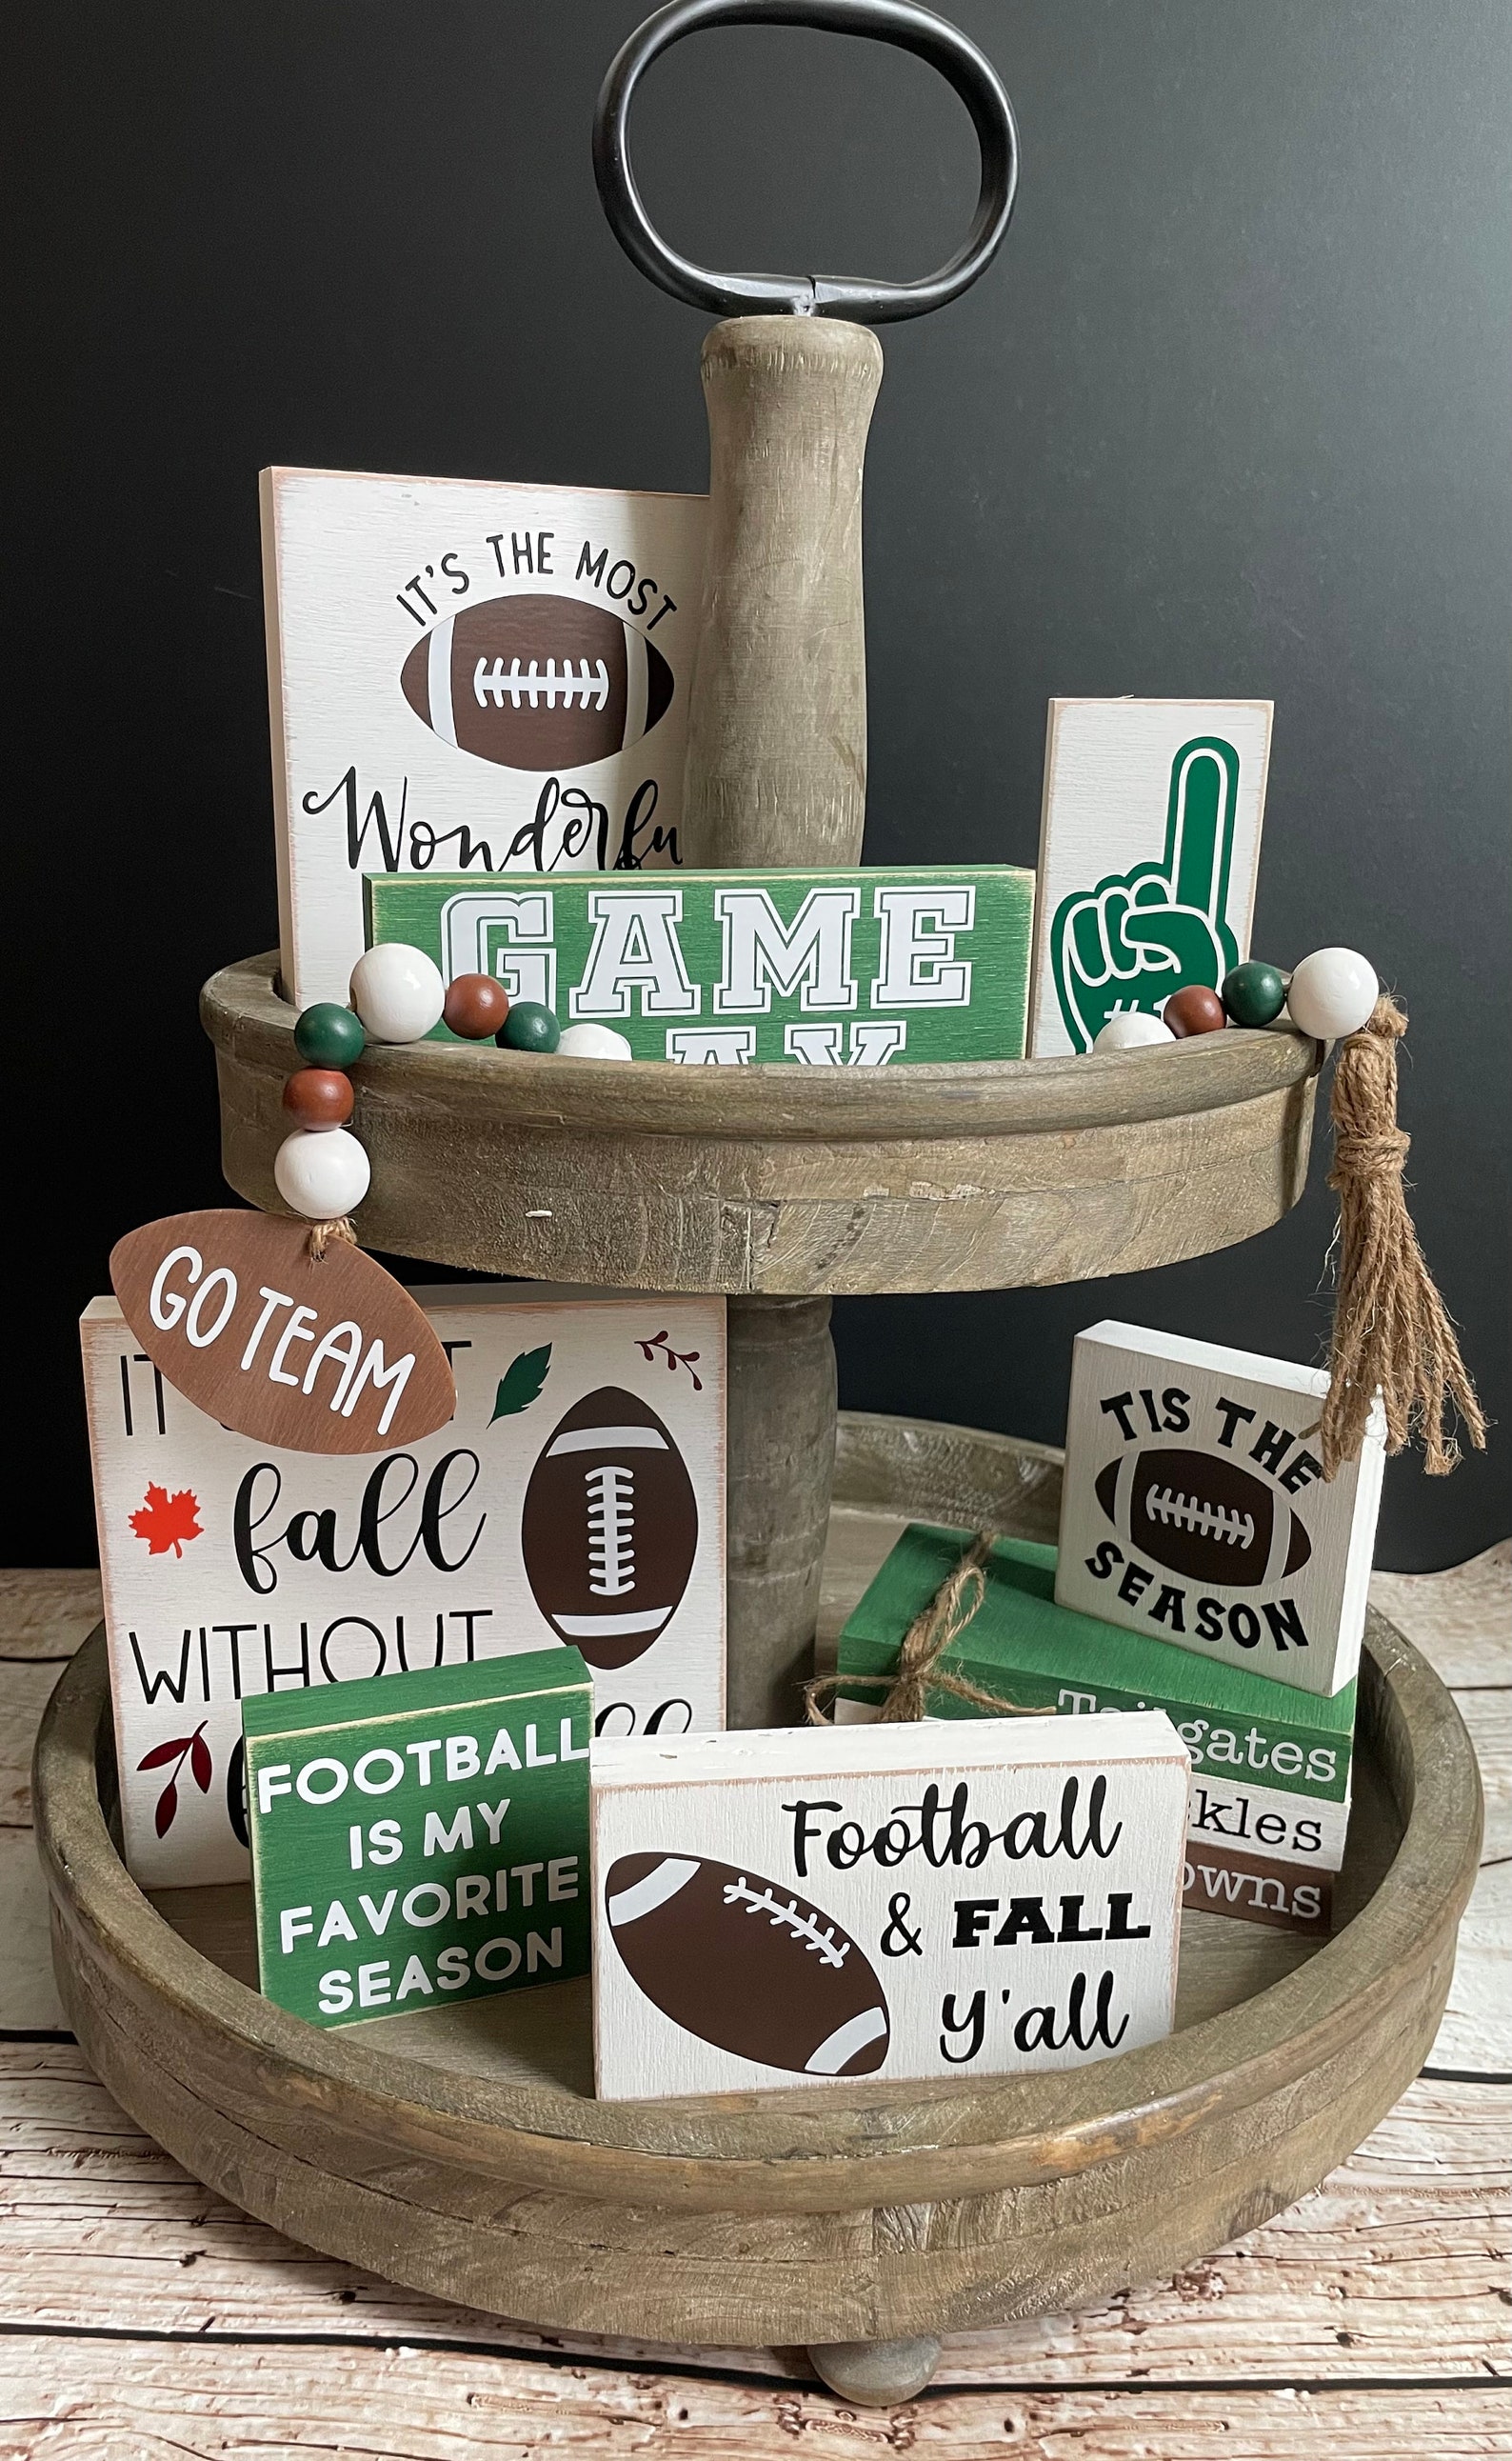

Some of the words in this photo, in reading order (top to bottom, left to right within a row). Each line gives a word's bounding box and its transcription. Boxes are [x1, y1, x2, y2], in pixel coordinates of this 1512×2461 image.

[396, 552, 469, 627] IT'S
[487, 531, 554, 577] THE
[576, 540, 678, 630] MOST
[441, 885, 976, 1019] GAME
[149, 1246, 238, 1349] GO
[240, 1285, 417, 1436] TEAM
[1100, 1387, 1191, 1442] TIS
[1215, 1396, 1324, 1495] THE
[233, 1448, 487, 1595] fall
[1084, 1540, 1309, 1652] SEASON
[129, 1610, 494, 1705] WITHOUT
[257, 1717, 590, 1815] FOOTBALL
[348, 1818, 404, 1871] IS
[423, 1798, 511, 1857] MY
[781, 1774, 1124, 1878] Football
[1187, 1788, 1323, 1852] kles
[279, 1855, 579, 1954] FAVORITE
[879, 1891, 924, 1957] &
[952, 1891, 1152, 1949] FALL
[317, 1927, 563, 2014] SEASON
